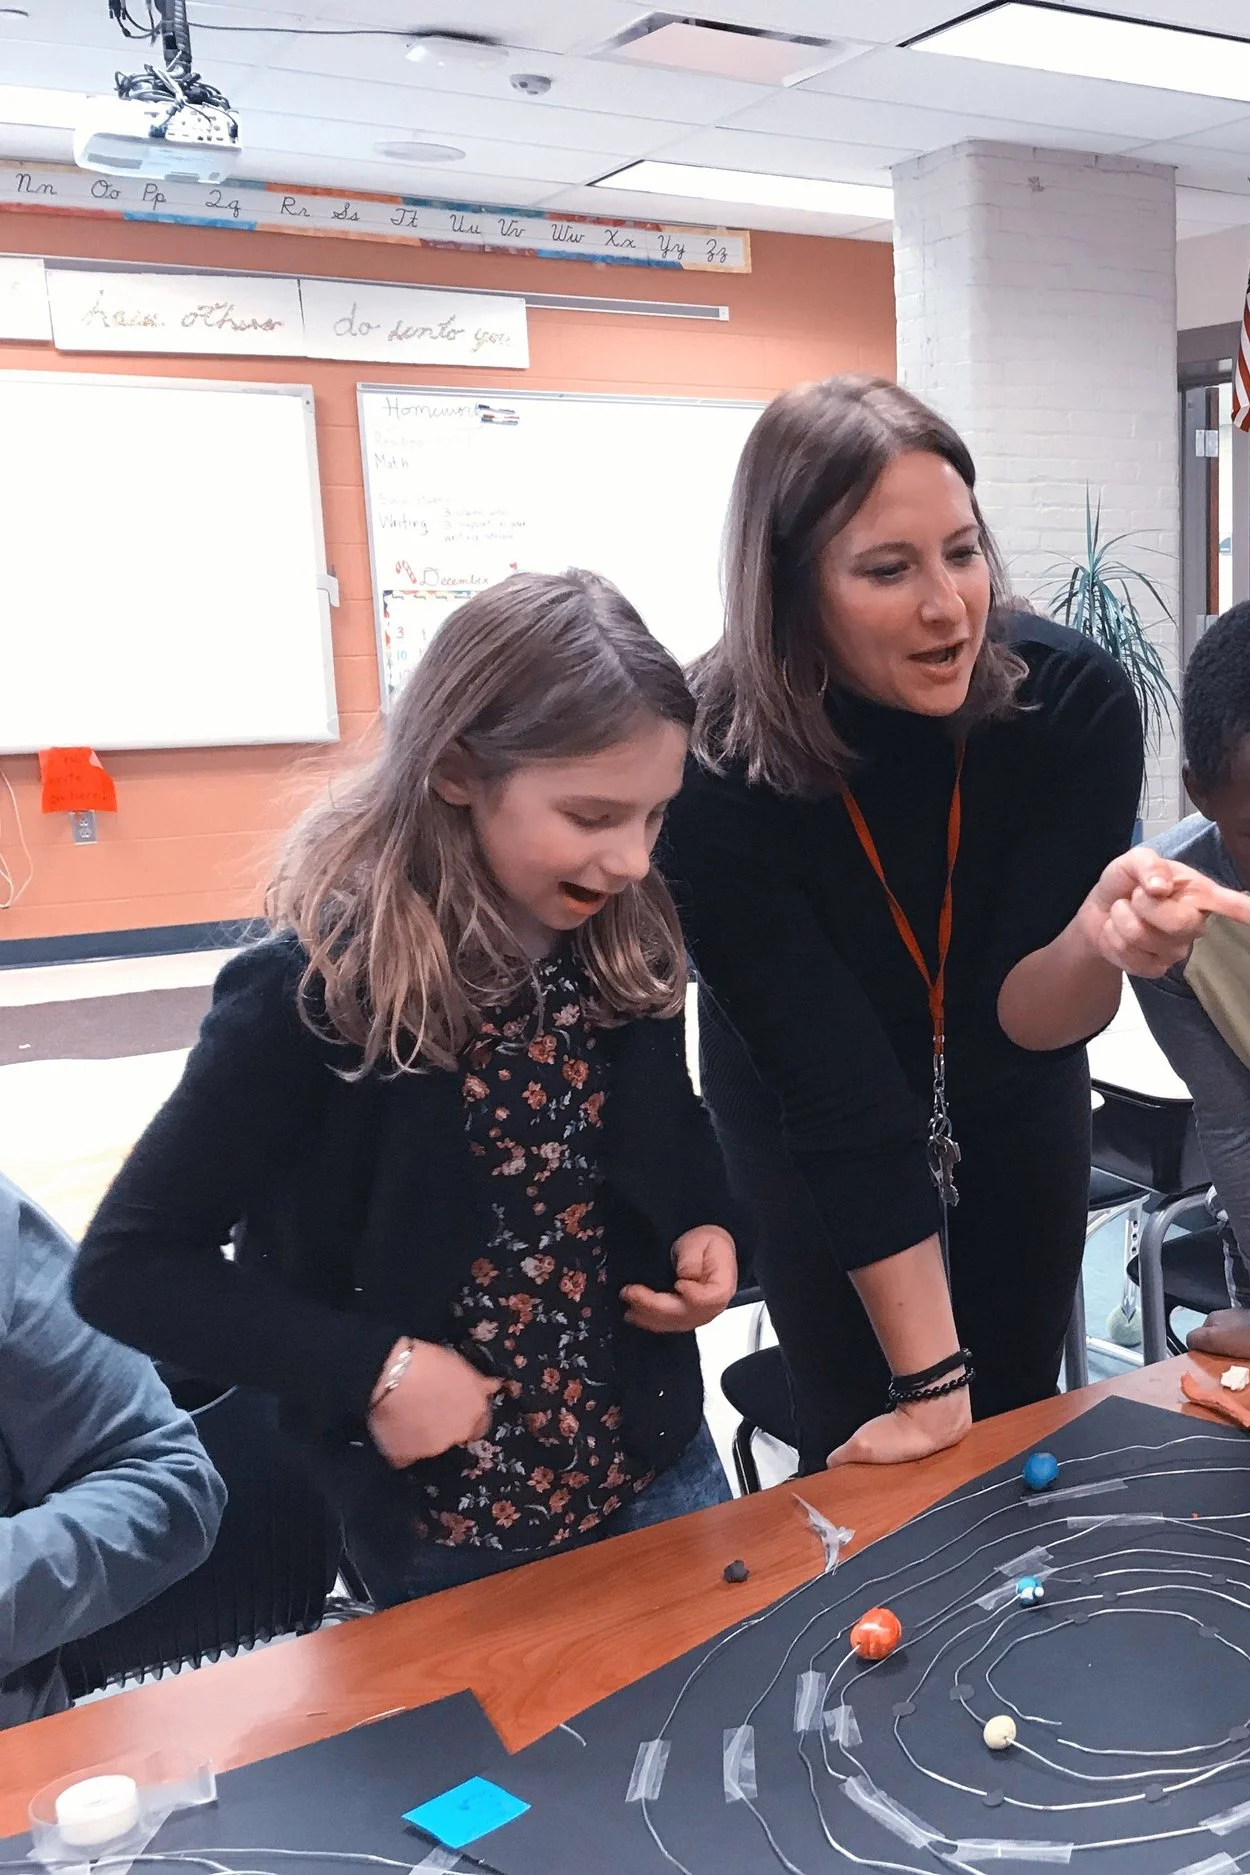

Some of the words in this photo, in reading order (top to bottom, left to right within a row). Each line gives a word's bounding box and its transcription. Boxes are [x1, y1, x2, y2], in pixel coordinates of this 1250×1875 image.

[16, 173, 57, 195] Nn
[91, 180, 122, 200] Oo
[142, 183, 167, 211] Pp
[280, 196, 311, 217] Rr
[331, 202, 360, 221] Ss
[390, 207, 418, 228] Tt
[449, 214, 482, 234] Uu
[497, 218, 526, 238] Vv
[551, 223, 586, 243] Ww
[604, 229, 636, 249] Xx
[658, 234, 686, 260] Yy
[706, 238, 728, 263] Zz
[333, 302, 381, 337] do
[382, 396, 481, 420] Homework
[374, 452, 409, 470] Math
[378, 512, 428, 536] Writing
[419, 567, 489, 587] December
